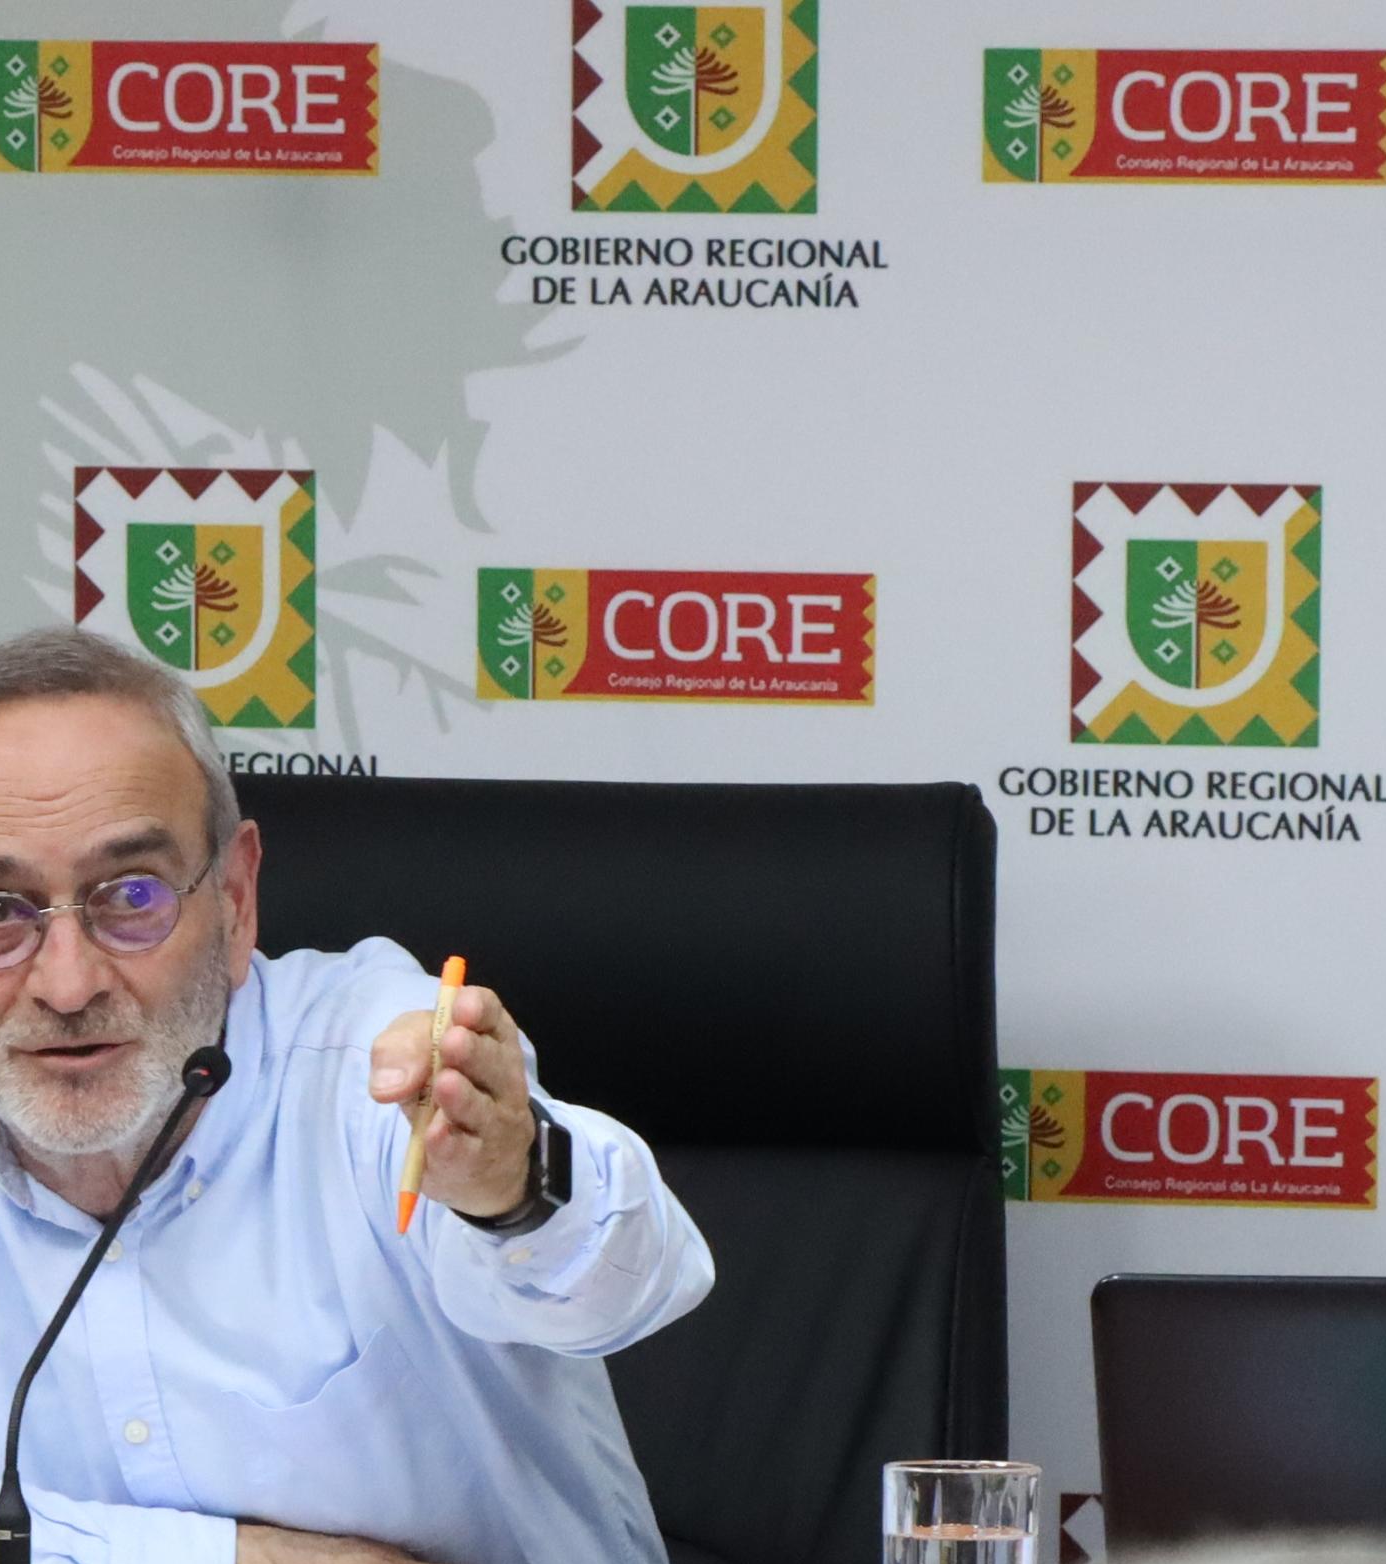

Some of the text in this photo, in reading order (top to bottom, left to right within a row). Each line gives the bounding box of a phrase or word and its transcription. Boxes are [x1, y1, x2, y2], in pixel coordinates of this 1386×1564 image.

[107, 61, 346, 135] CORE
[1111, 70, 1358, 144] CORE
[111, 144, 170, 162] Consejo
[170, 145, 232, 164] Regional
[233, 148, 252, 161] de
[253, 147, 273, 162] La
[1116, 153, 1175, 172] Consejo
[1175, 155, 1239, 173] Regional
[1240, 157, 1260, 171] de
[1261, 157, 1281, 172] La
[500, 235, 888, 269] GOBIERNO REGIONAL
[532, 272, 859, 309] DE LA ARAUCANÍA
[603, 589, 843, 664] CORE
[607, 672, 663, 690] Consejo
[664, 673, 727, 692] Regional
[727, 676, 747, 691] de
[748, 676, 768, 692] La
[218, 751, 377, 776] EGIONA
[998, 766, 1194, 799] GOBIERNO
[1030, 804, 1363, 842] DE LA ARAUCANÍA
[1100, 1092, 1345, 1168] CORE
[1105, 1175, 1164, 1194] Consejo
[1164, 1176, 1228, 1195] Regional
[1228, 1180, 1248, 1193] de
[1250, 1179, 1269, 1194] La
